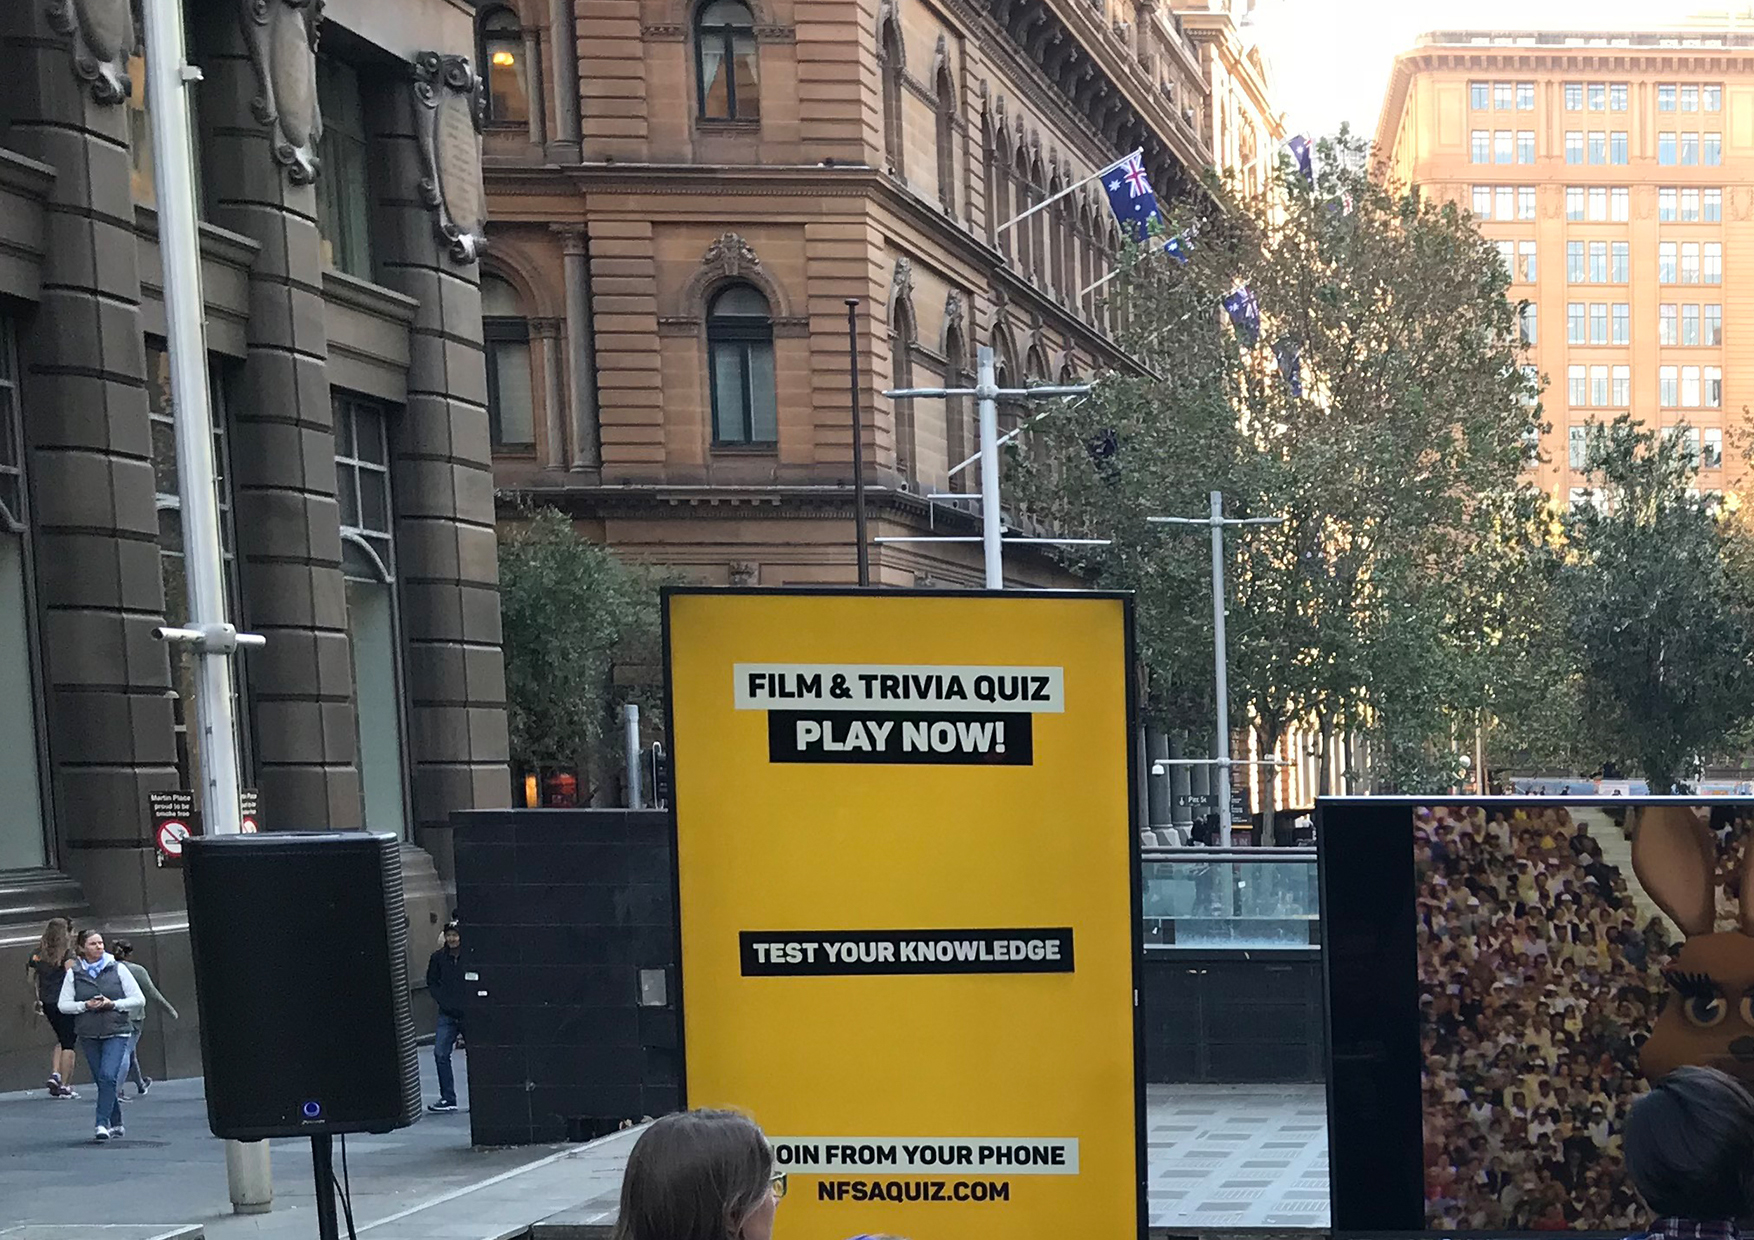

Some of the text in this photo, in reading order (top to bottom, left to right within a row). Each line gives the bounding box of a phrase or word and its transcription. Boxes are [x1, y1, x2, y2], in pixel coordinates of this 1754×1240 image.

[749, 673, 1050, 703] FILM & TRIVIA QUIZ
[797, 721, 1005, 752] PLAY NOW!
[753, 940, 1060, 963] TEST YOUR KNOWLEDGE
[771, 1145, 1065, 1165] OIN FROM YOUR PHONE
[818, 1181, 1009, 1203] NFSAQUIZ.COM
